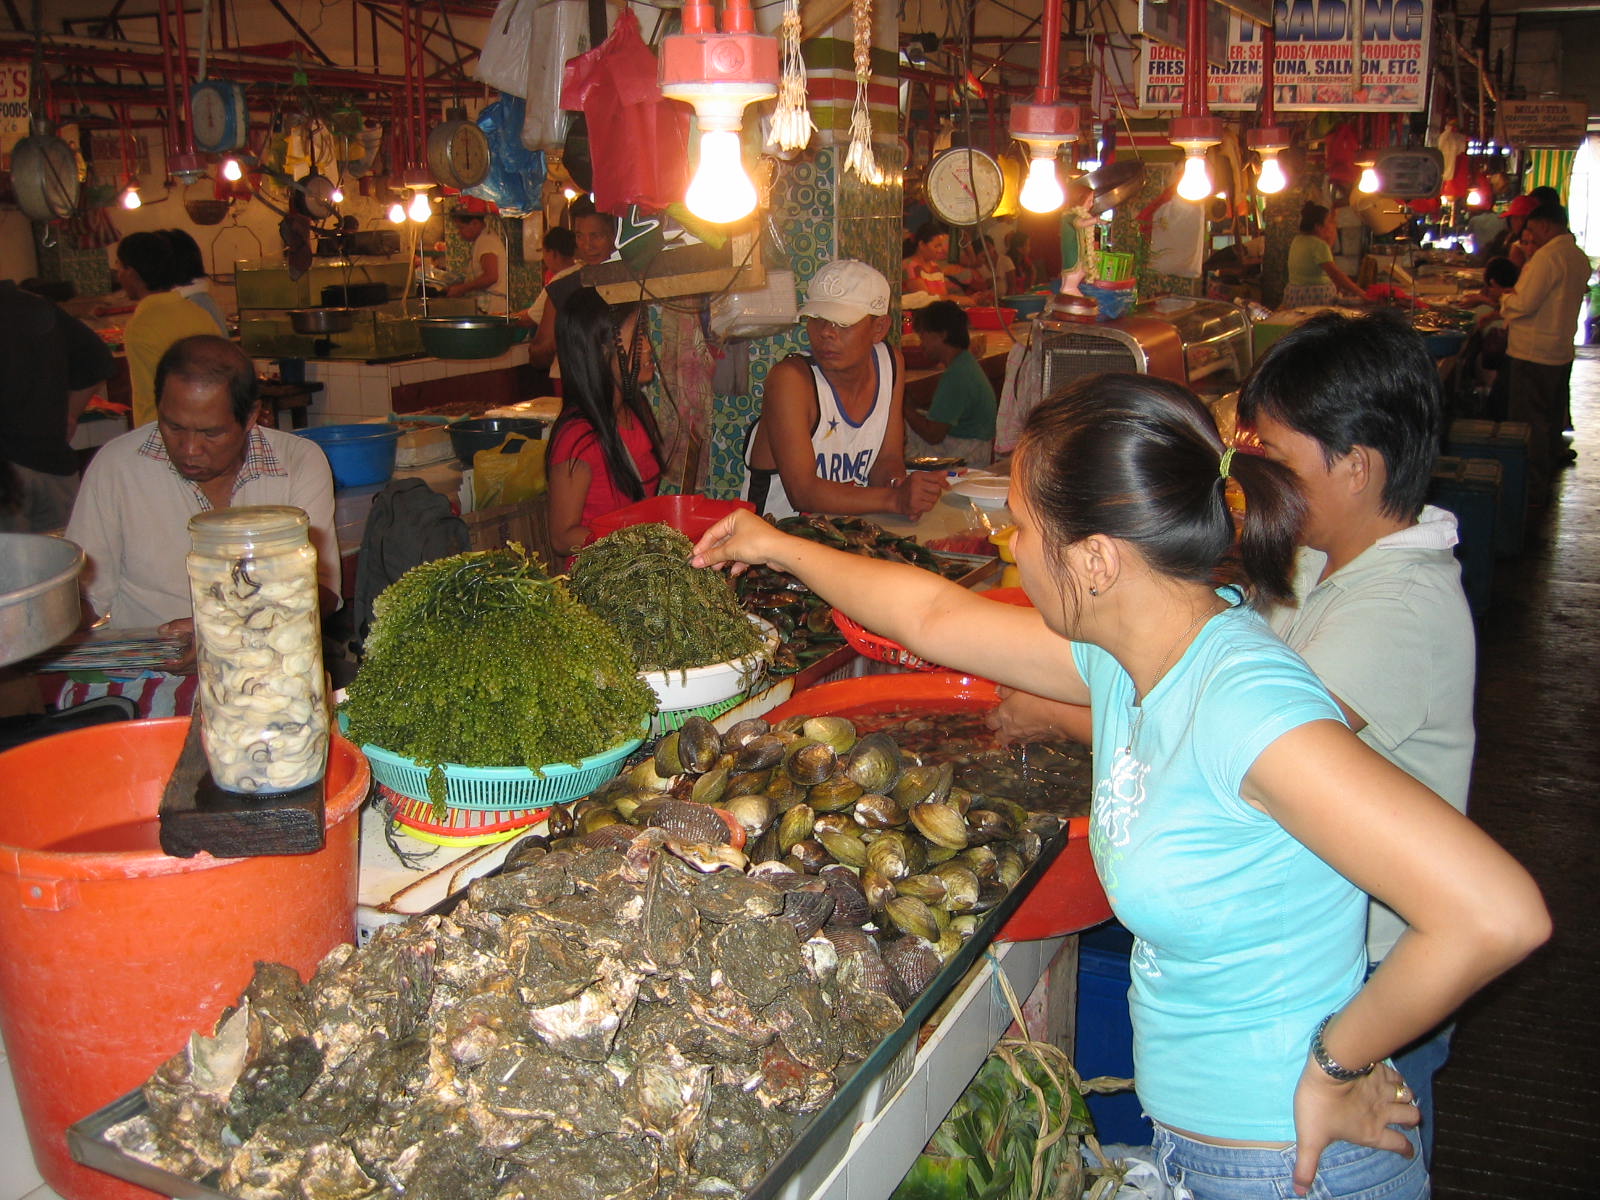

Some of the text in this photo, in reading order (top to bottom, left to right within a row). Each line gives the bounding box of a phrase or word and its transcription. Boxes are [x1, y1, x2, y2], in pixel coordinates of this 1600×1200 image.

[1149, 60, 1184, 75] FRES
[1275, 60, 1310, 75] UNA,
[1388, 60, 1421, 75] ETC.
[0, 102, 28, 118] OODS
